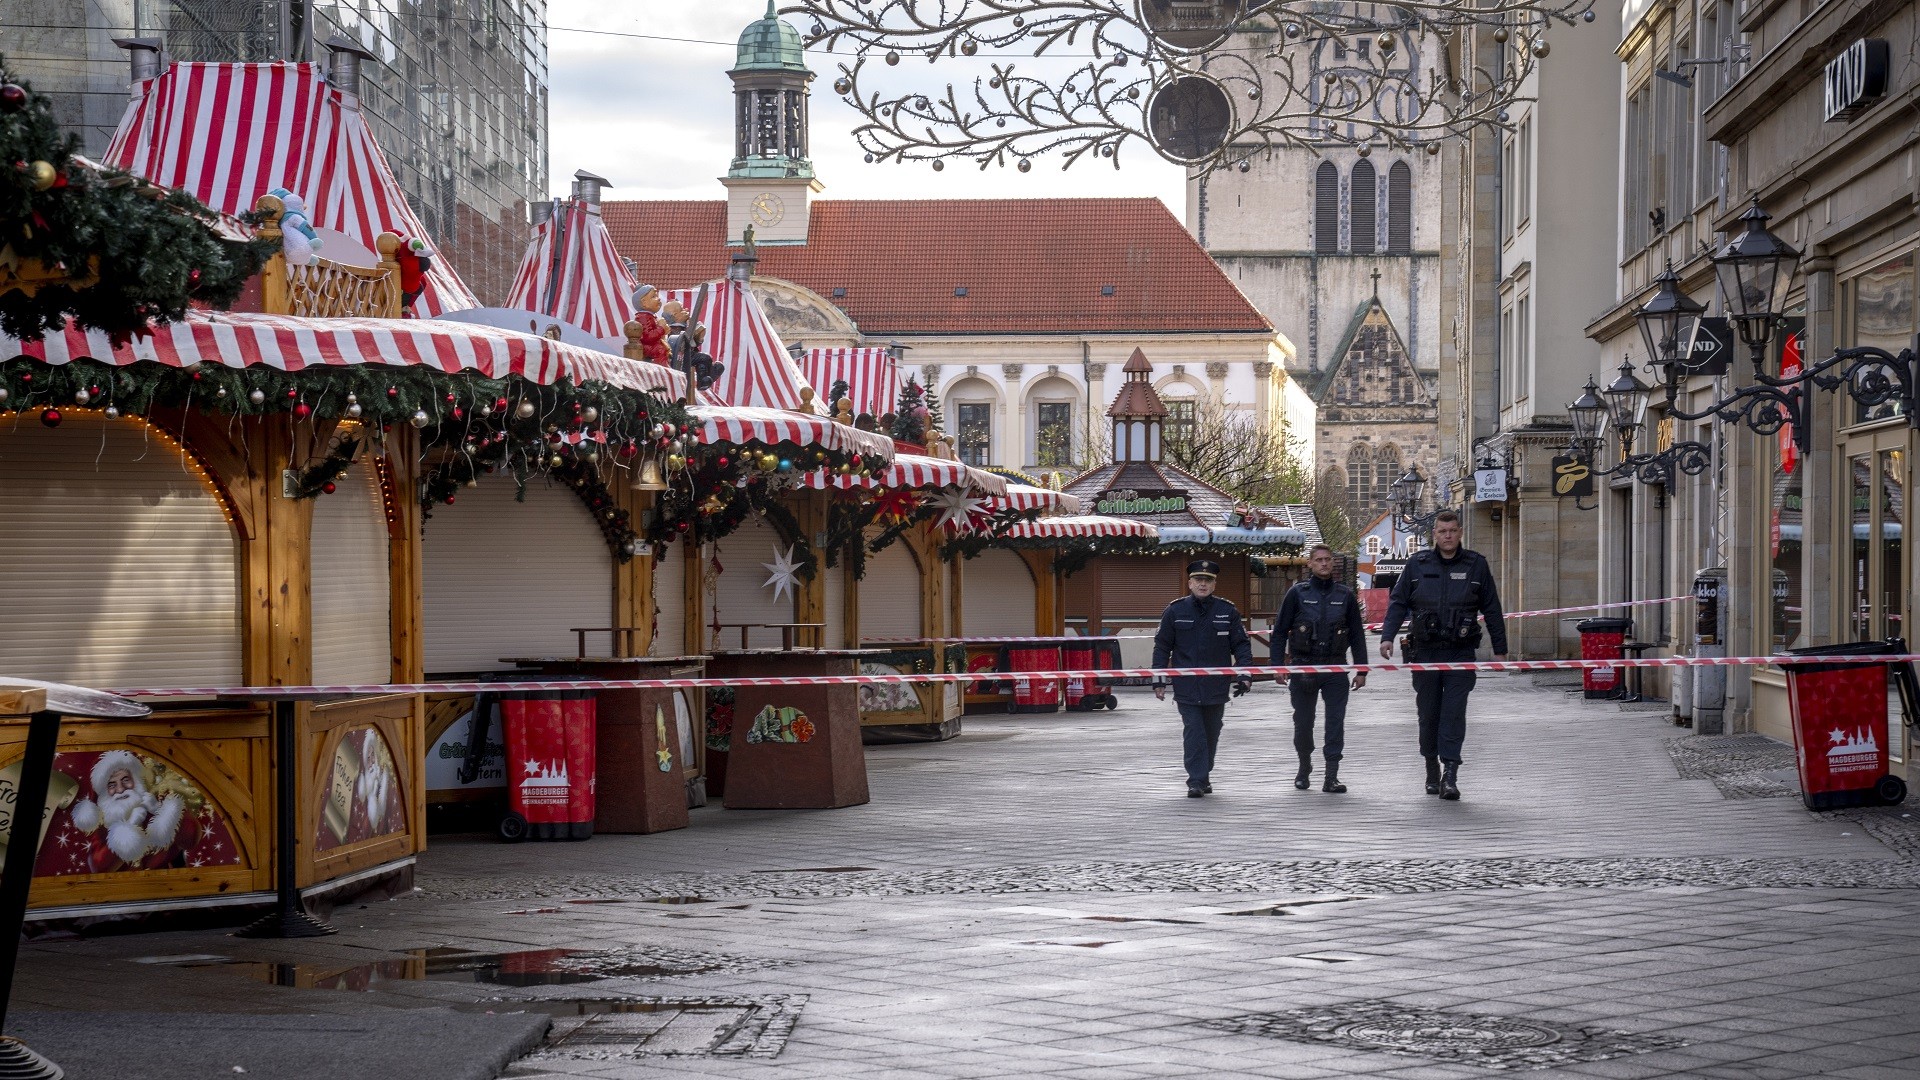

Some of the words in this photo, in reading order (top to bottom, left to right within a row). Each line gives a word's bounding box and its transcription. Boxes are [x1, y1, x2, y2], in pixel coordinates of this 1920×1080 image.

[1824, 37, 1866, 123] KIND
[1677, 340, 1716, 352] KND
[1097, 496, 1186, 514] Grillstübchen
[1829, 754, 1878, 764] MAGDEBURGER
[457, 767, 502, 781] Mtern
[1830, 764, 1879, 773] WEIHNACHTSMARKT
[521, 787, 569, 796] MAGDEBURGER
